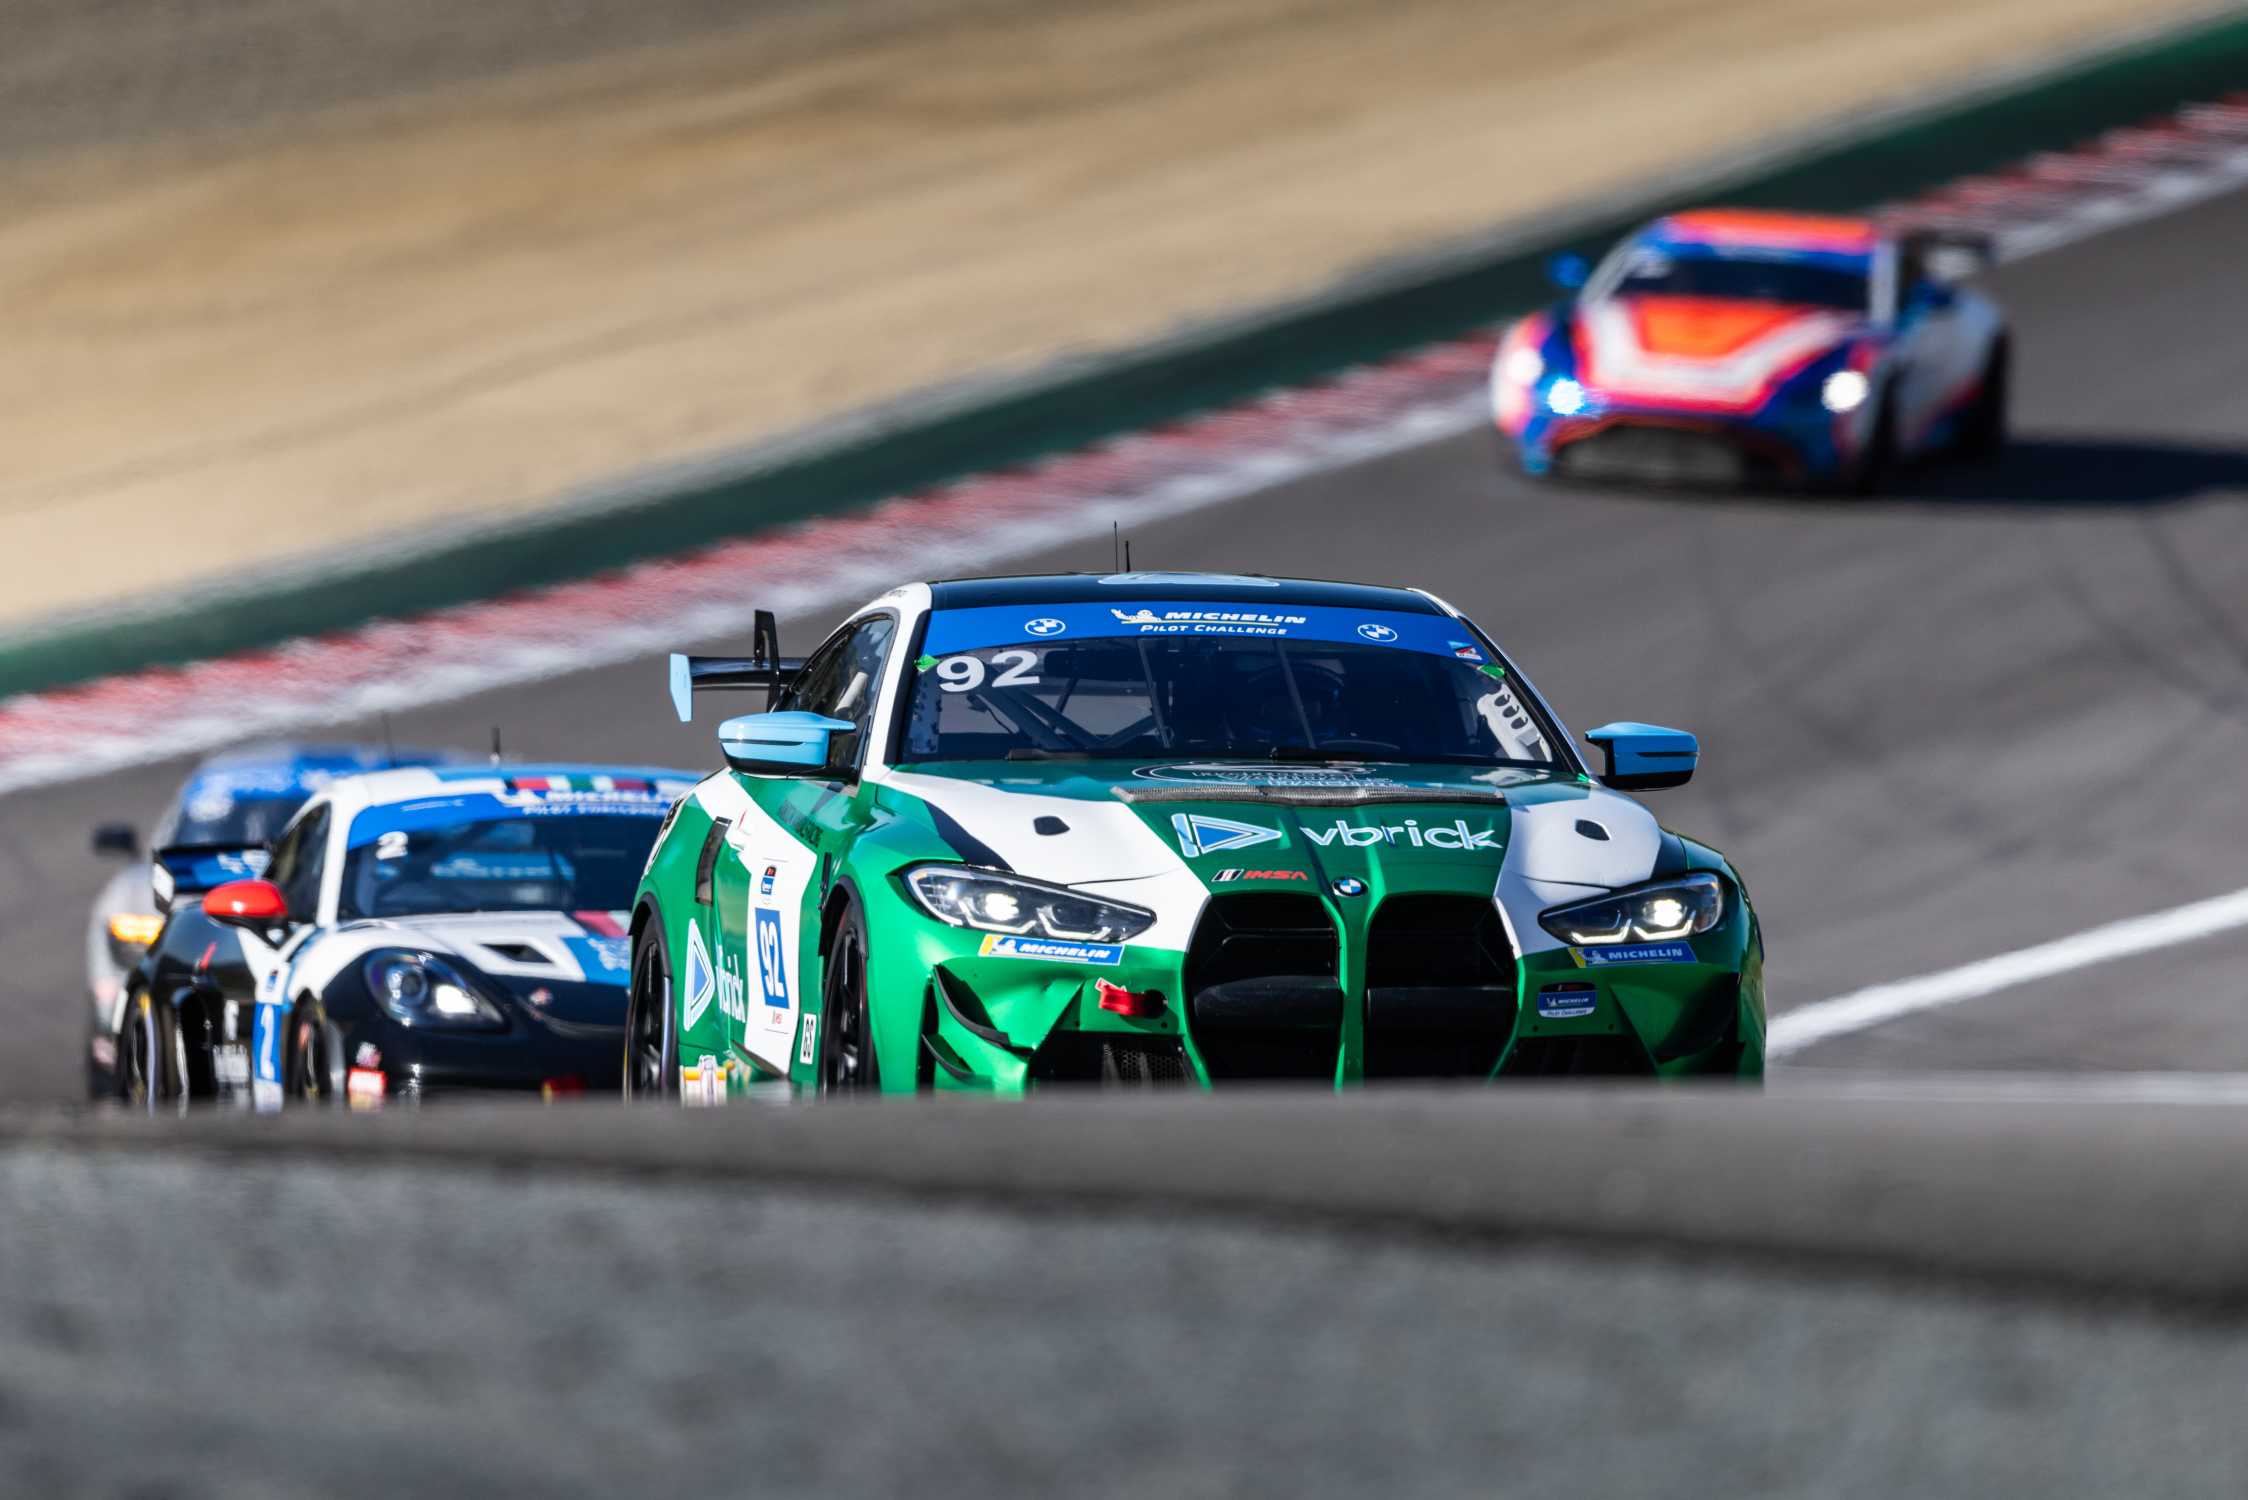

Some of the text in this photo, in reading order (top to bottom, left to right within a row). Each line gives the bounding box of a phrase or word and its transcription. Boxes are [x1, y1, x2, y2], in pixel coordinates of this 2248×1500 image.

[1164, 610, 1306, 624] MICHELIN
[1140, 624, 1288, 635] PILOT CHALLENGE
[936, 650, 1040, 692] 92
[1300, 820, 1503, 850] vbrick
[376, 831, 409, 860] 2
[1243, 870, 1308, 880] IMSA
[760, 920, 785, 998] 92
[1019, 943, 1112, 959] MICHELIN
[1608, 948, 1683, 960] MICHELIN
